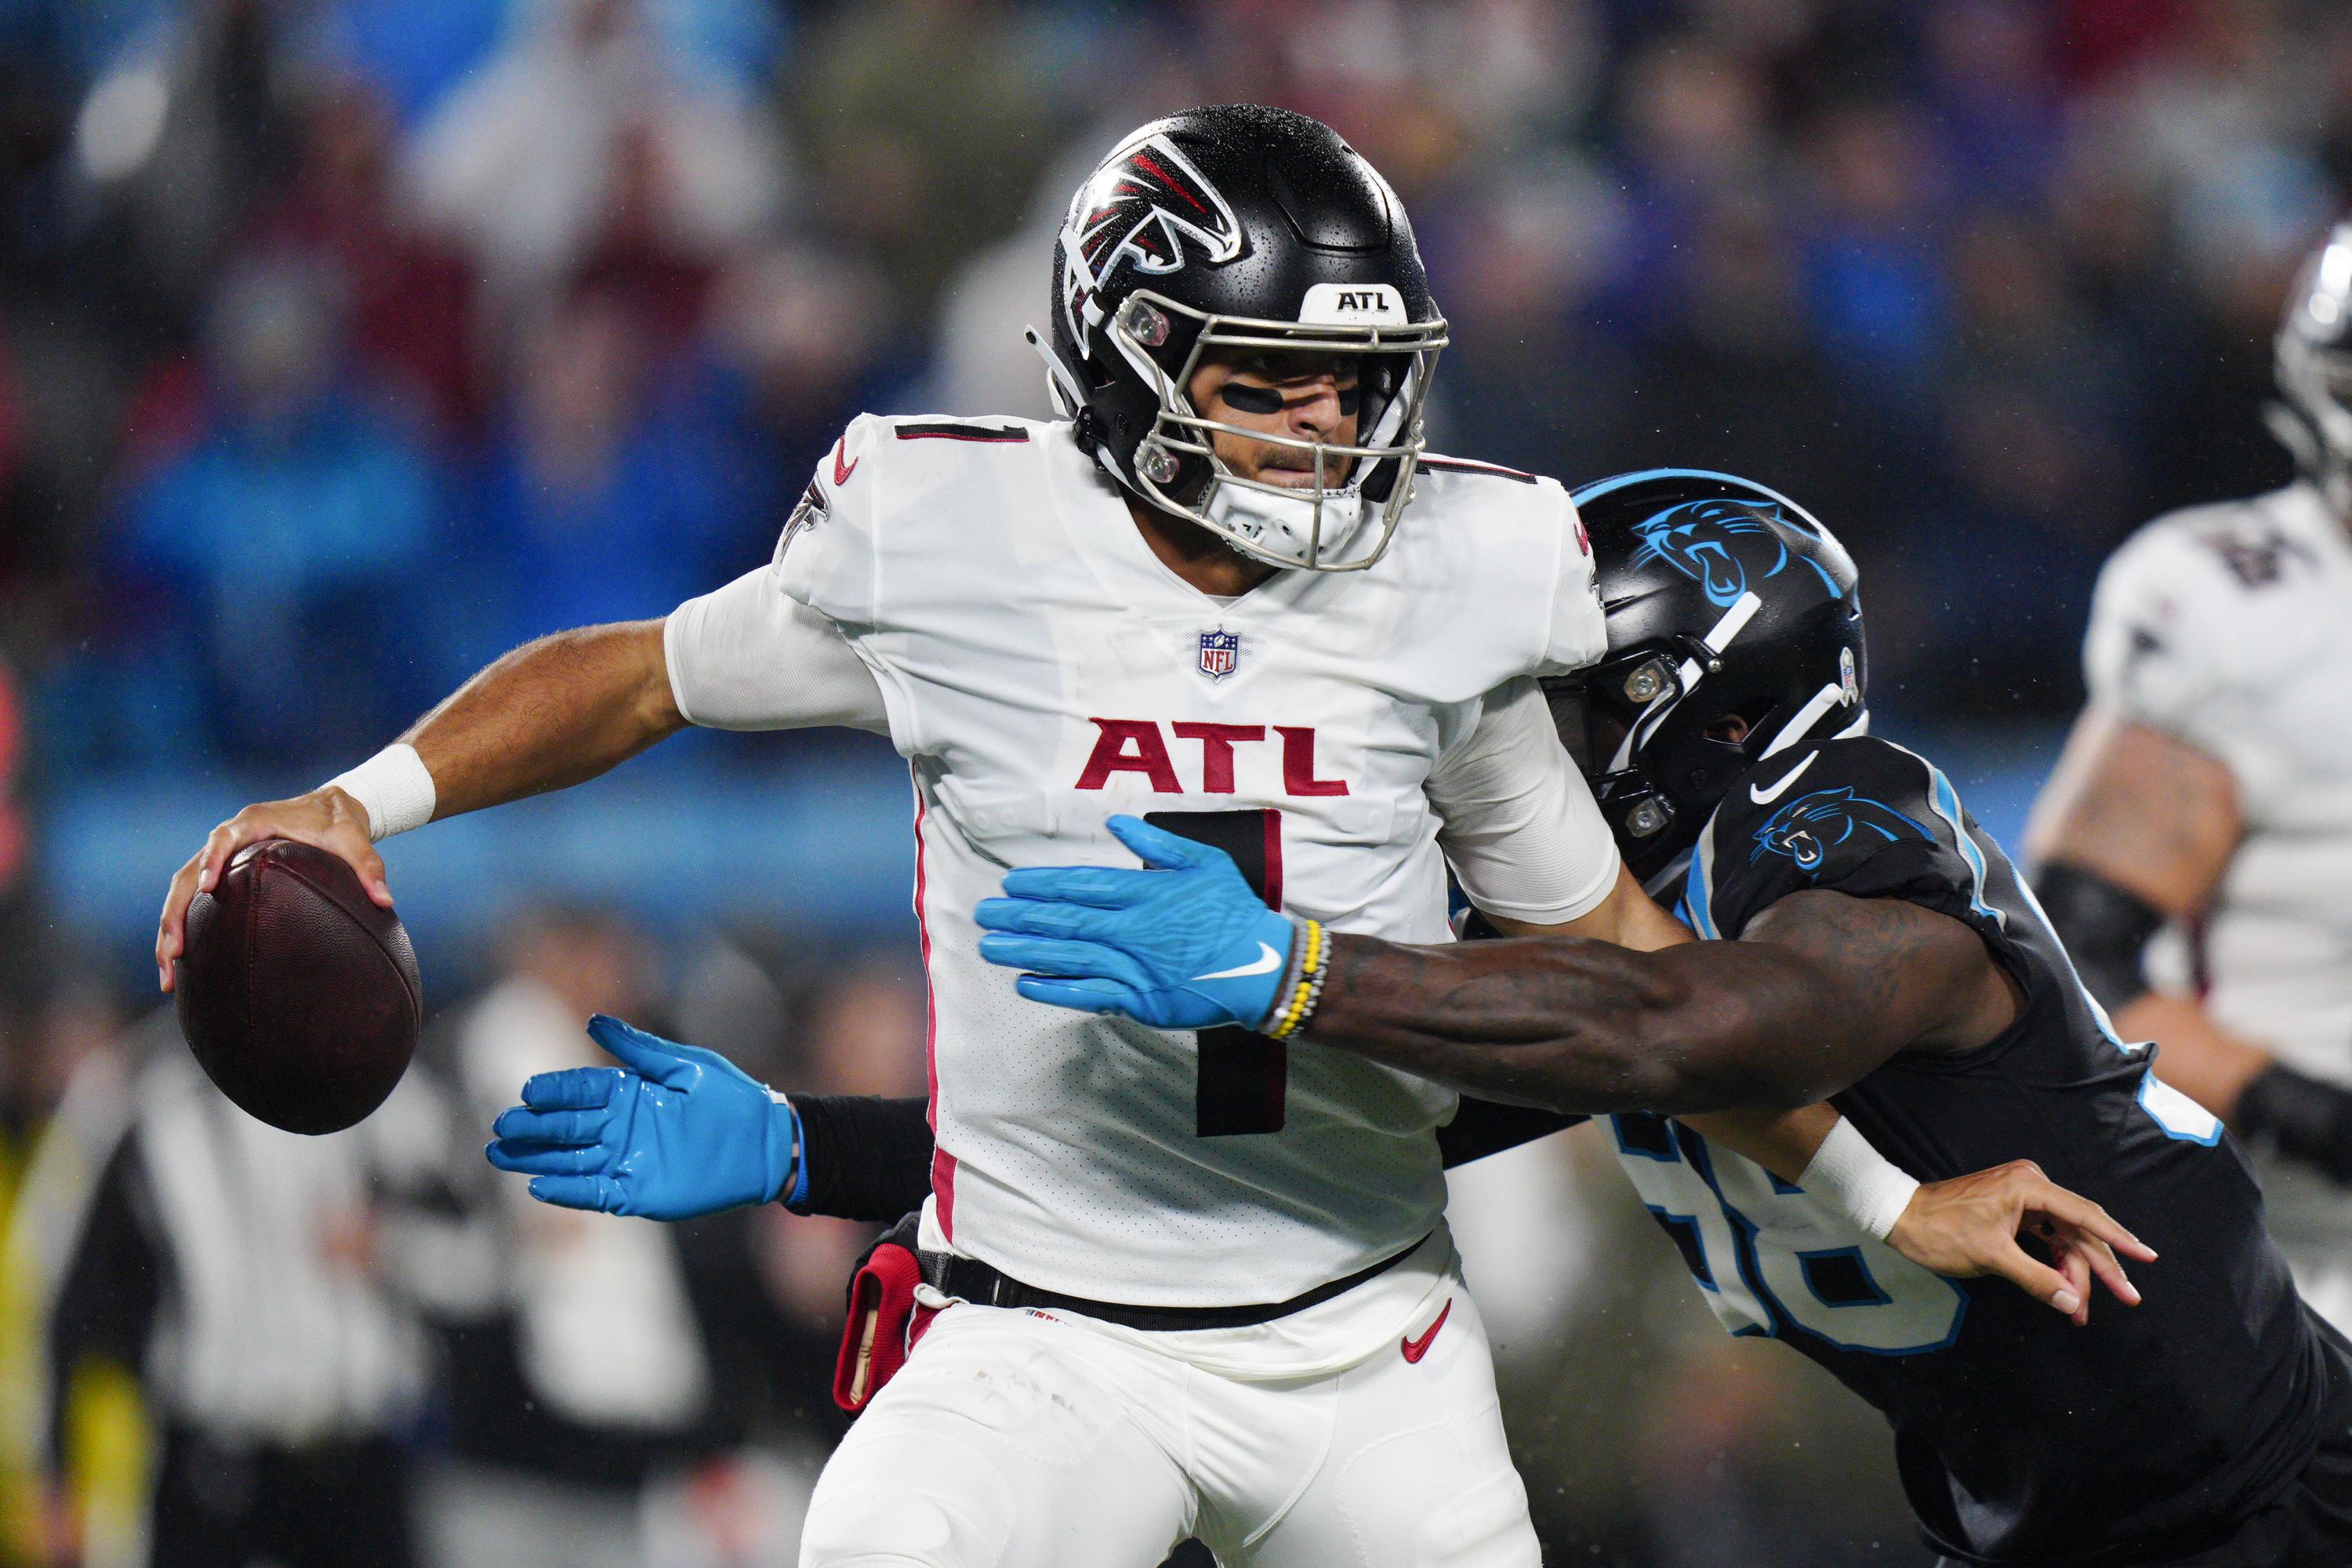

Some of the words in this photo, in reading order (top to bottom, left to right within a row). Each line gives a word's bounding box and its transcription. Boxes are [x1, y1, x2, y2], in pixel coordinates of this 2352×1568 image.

[1338, 292, 1388, 310] ATL
[1203, 650, 1233, 673] NFL
[1075, 717, 1349, 795] ATL
